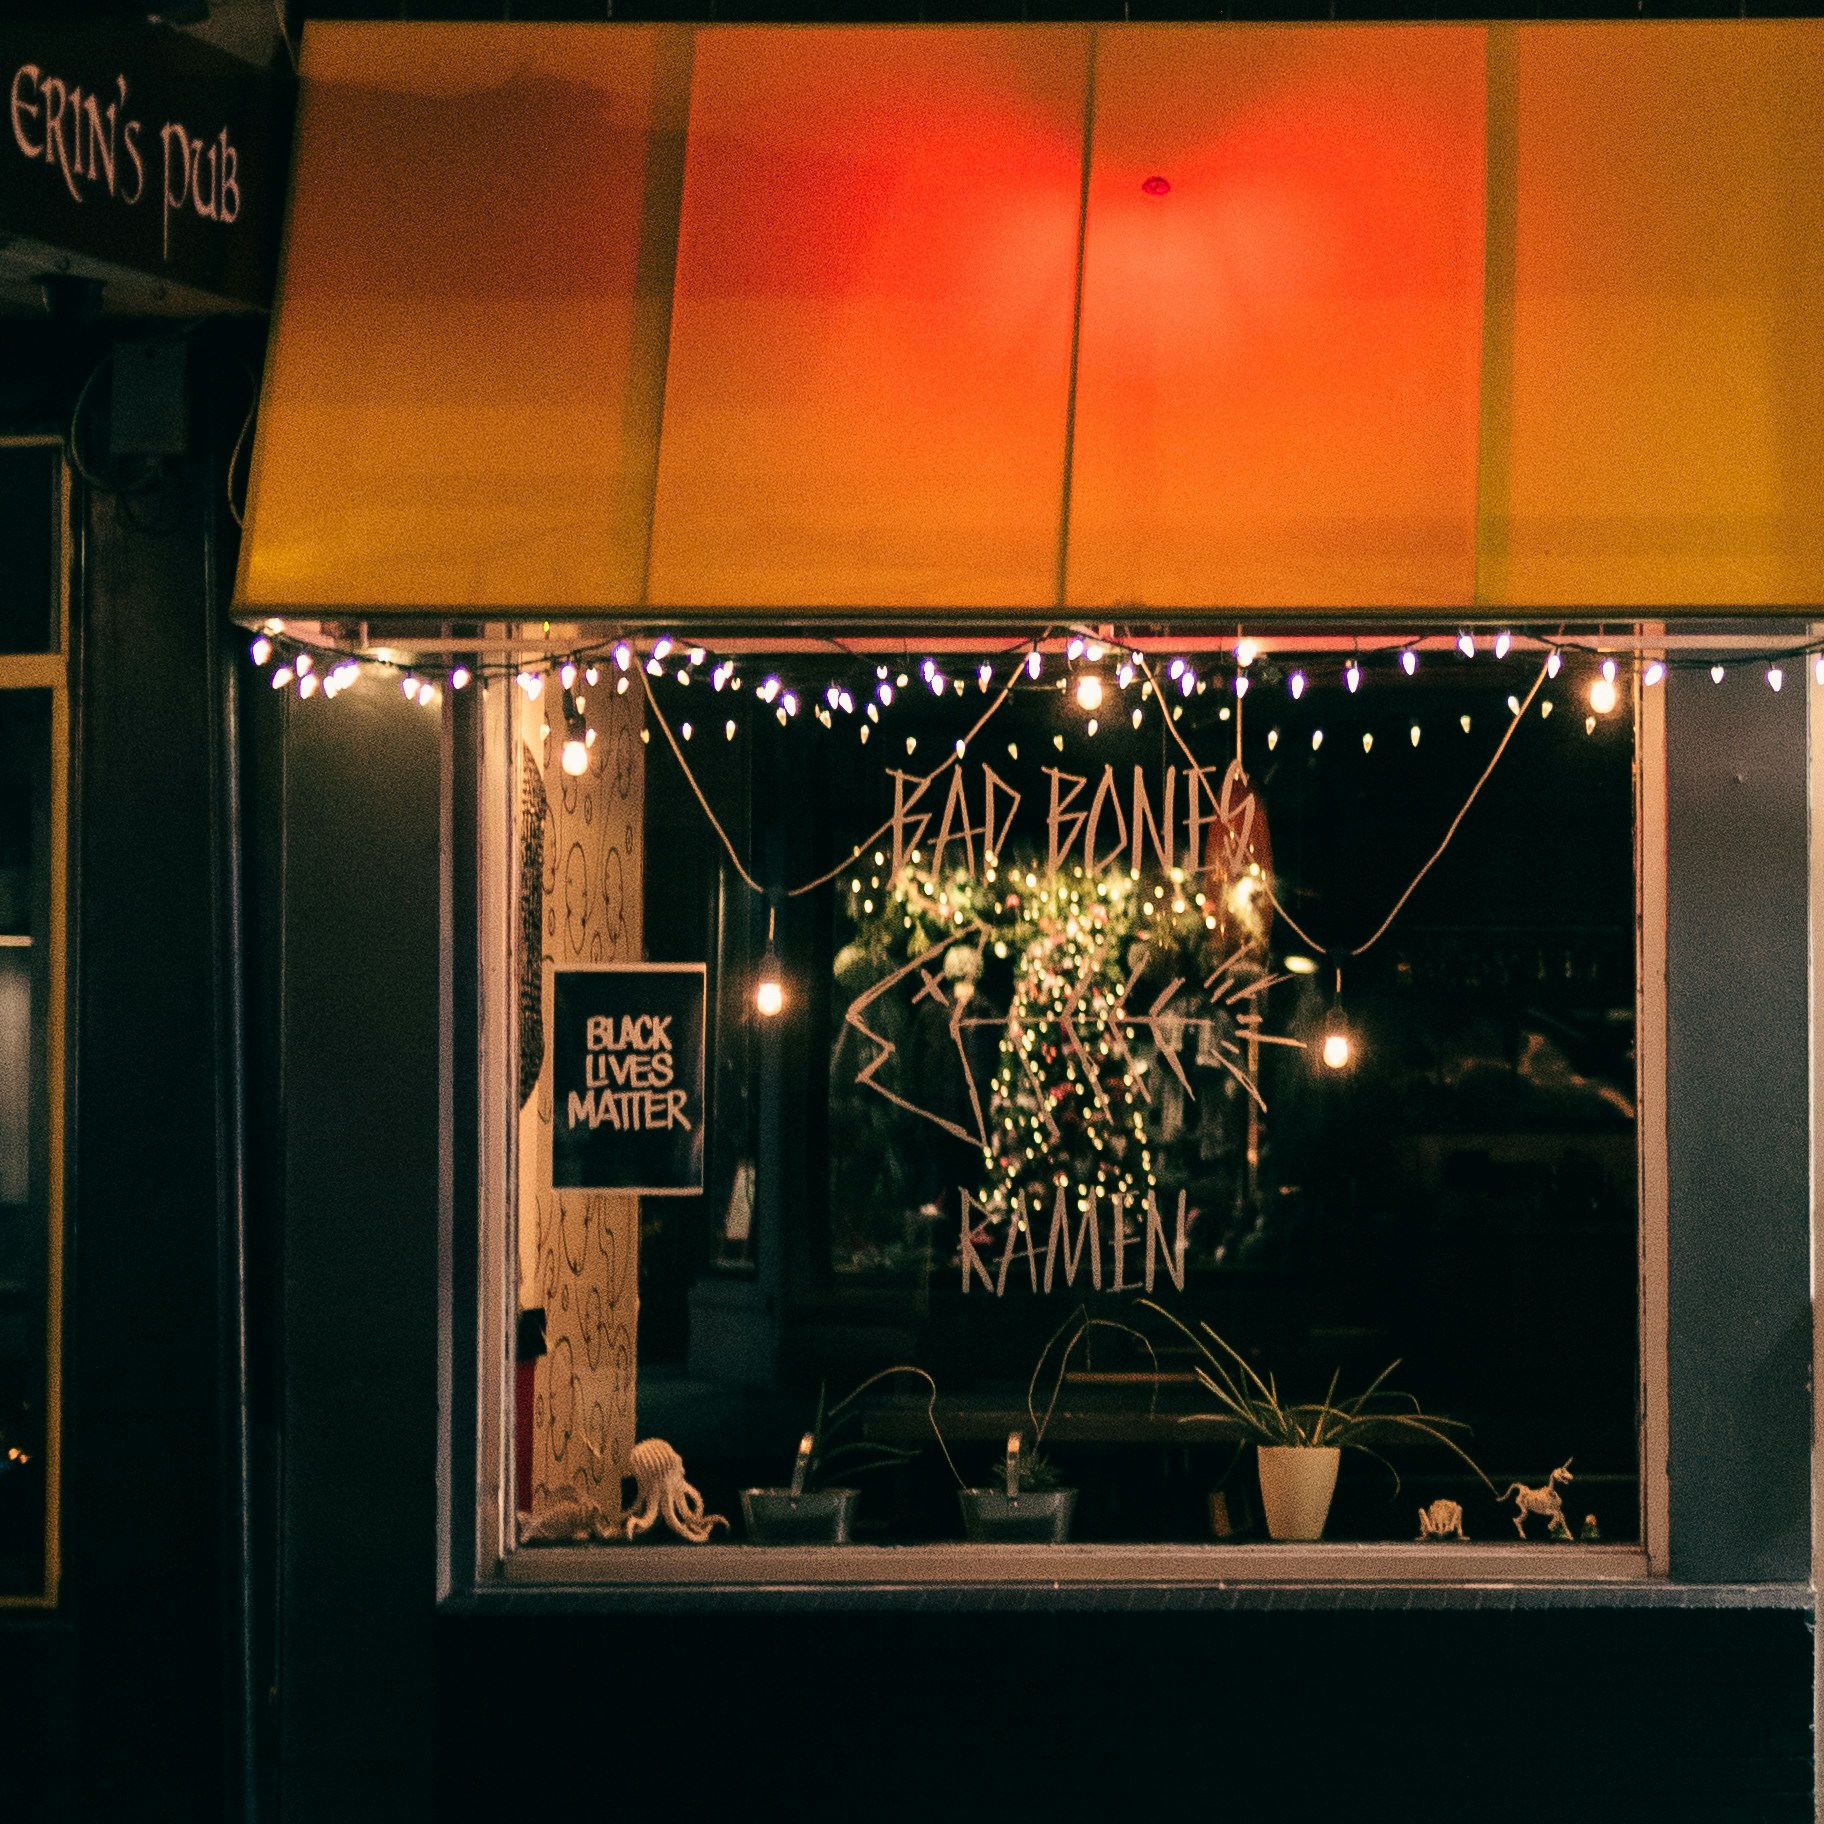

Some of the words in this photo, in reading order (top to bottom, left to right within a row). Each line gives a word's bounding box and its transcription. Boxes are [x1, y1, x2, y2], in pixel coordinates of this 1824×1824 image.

[885, 762, 1021, 889] BAD
[1041, 758, 1256, 880] BONES
[586, 1014, 672, 1052] BLACK
[585, 1052, 674, 1090] LIVES
[566, 1089, 692, 1131] MATTER
[958, 1185, 1187, 1297] RAMEN
